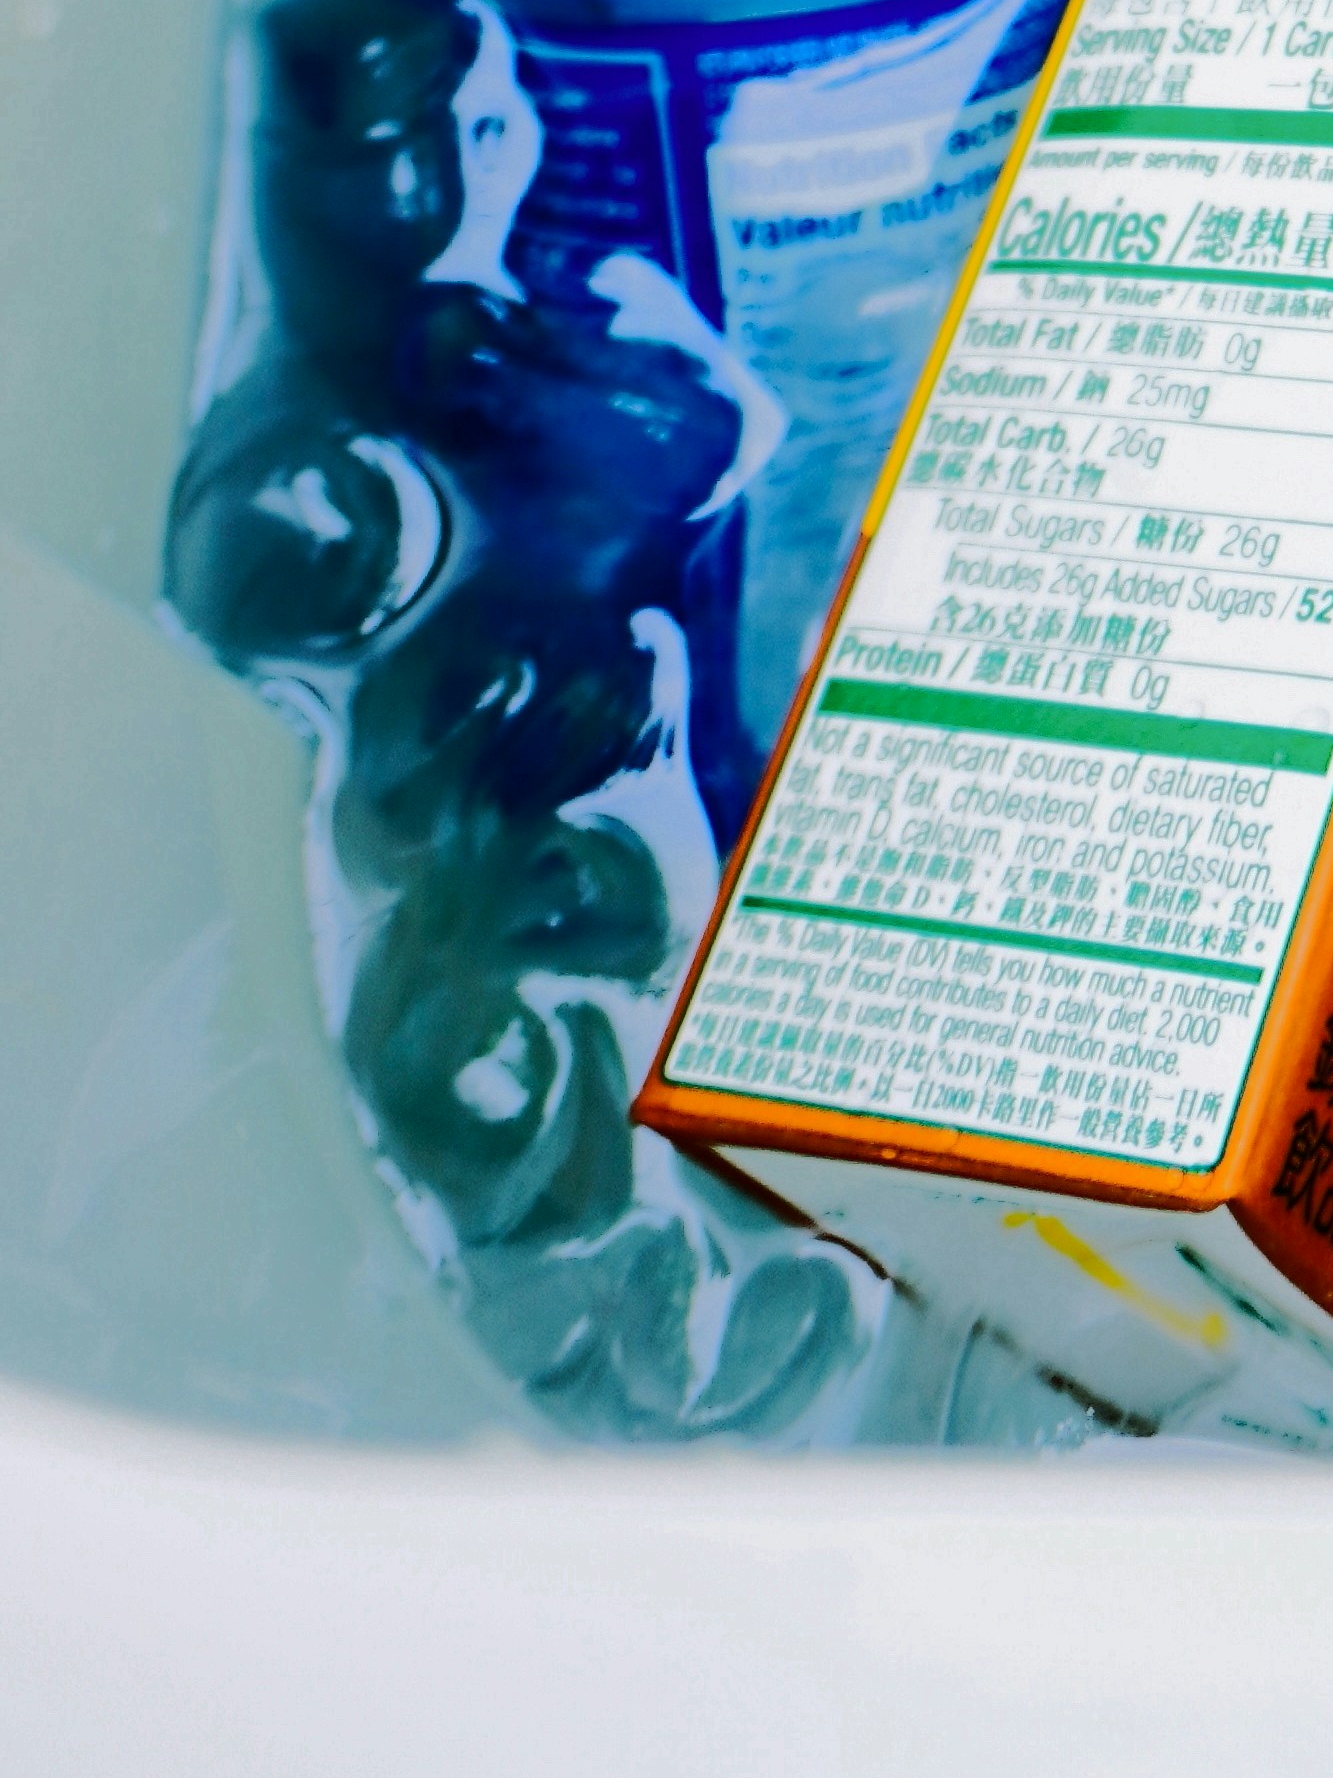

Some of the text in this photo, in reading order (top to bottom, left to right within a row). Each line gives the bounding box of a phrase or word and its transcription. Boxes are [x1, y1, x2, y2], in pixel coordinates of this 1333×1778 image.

[1070, 23, 1166, 65] Serving
[1170, 16, 1232, 55] Size
[1027, 146, 1219, 177] Amount per serving
[733, 209, 863, 248] Valeur
[996, 195, 1167, 266] Calories
[1041, 275, 1095, 307] Daily
[965, 315, 1027, 347] Total
[1029, 317, 1080, 350] Fat
[1223, 331, 1263, 372] 0g
[939, 364, 1047, 398] Sodium
[1125, 372, 1211, 421] 25mg
[927, 410, 992, 447] Total
[994, 414, 1070, 455] Carb.
[1105, 425, 1165, 469] 26g
[936, 495, 1000, 533] Total
[1004, 502, 1105, 551] Sugars
[1217, 523, 1281, 569] 26g
[943, 550, 1041, 591] Includes
[1046, 560, 1098, 607] 26g
[1100, 568, 1185, 608] Added
[1186, 574, 1276, 622] Sugars
[833, 633, 943, 676] Protein
[1128, 662, 1170, 712] 0g
[803, 719, 1274, 809] Not significant source of saturated
[833, 764, 903, 802] trans
[949, 778, 1098, 831] cholesterol,
[1107, 798, 1203, 849] dietary
[1207, 808, 1274, 856] fiber,
[773, 797, 862, 834] vitamin
[899, 815, 1002, 860] calcium,
[1070, 839, 1127, 873] and
[1125, 846, 1273, 899] potassium.
[848, 963, 896, 995] food
[895, 974, 1007, 1012] contributes
[1052, 996, 1105, 1034] daily
[1153, 1008, 1221, 1047] 2,000
[849, 927, 904, 964] Value
[904, 936, 950, 974] (DV)
[951, 941, 994, 976] tells
[992, 957, 1036, 991] you
[1037, 954, 1086, 990] how
[1087, 969, 1148, 999] much
[1168, 980, 1256, 1017] nutrient
[795, 988, 832, 1027] day
[854, 1003, 908, 1031] used
[907, 1004, 938, 1035] for
[937, 1015, 1019, 1048] general
[1019, 1027, 1106, 1061] nutrition
[1108, 1040, 1180, 1076] advice.
